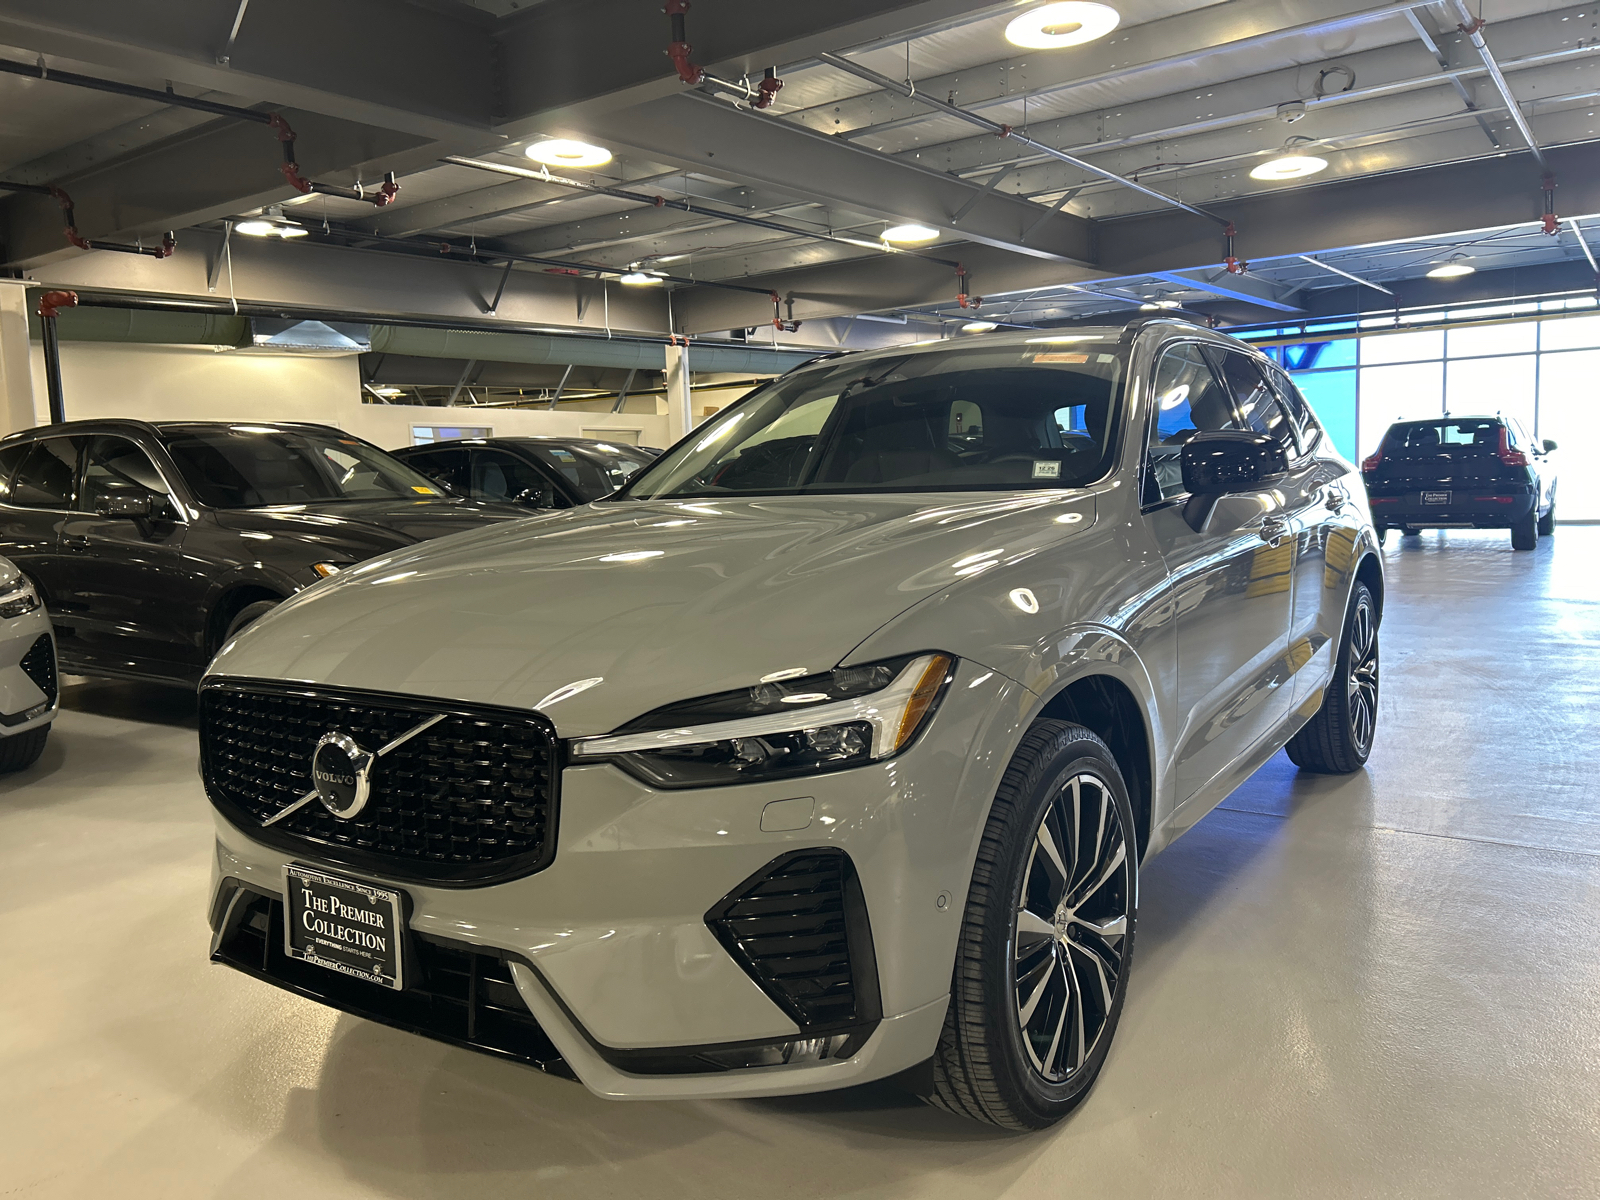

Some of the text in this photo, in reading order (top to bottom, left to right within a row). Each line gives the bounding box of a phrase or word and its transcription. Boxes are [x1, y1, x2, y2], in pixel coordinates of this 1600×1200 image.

[315, 770, 355, 786] VOLVO
[323, 876, 355, 891] EXCELLENCE
[355, 885, 372, 895] SINCE
[373, 889, 389, 900] 1995
[301, 888, 385, 929] THE PREMIER
[302, 910, 386, 952] COLLECTION
[315, 937, 343, 951] EVERYTHING
[342, 945, 360, 956] STARTS
